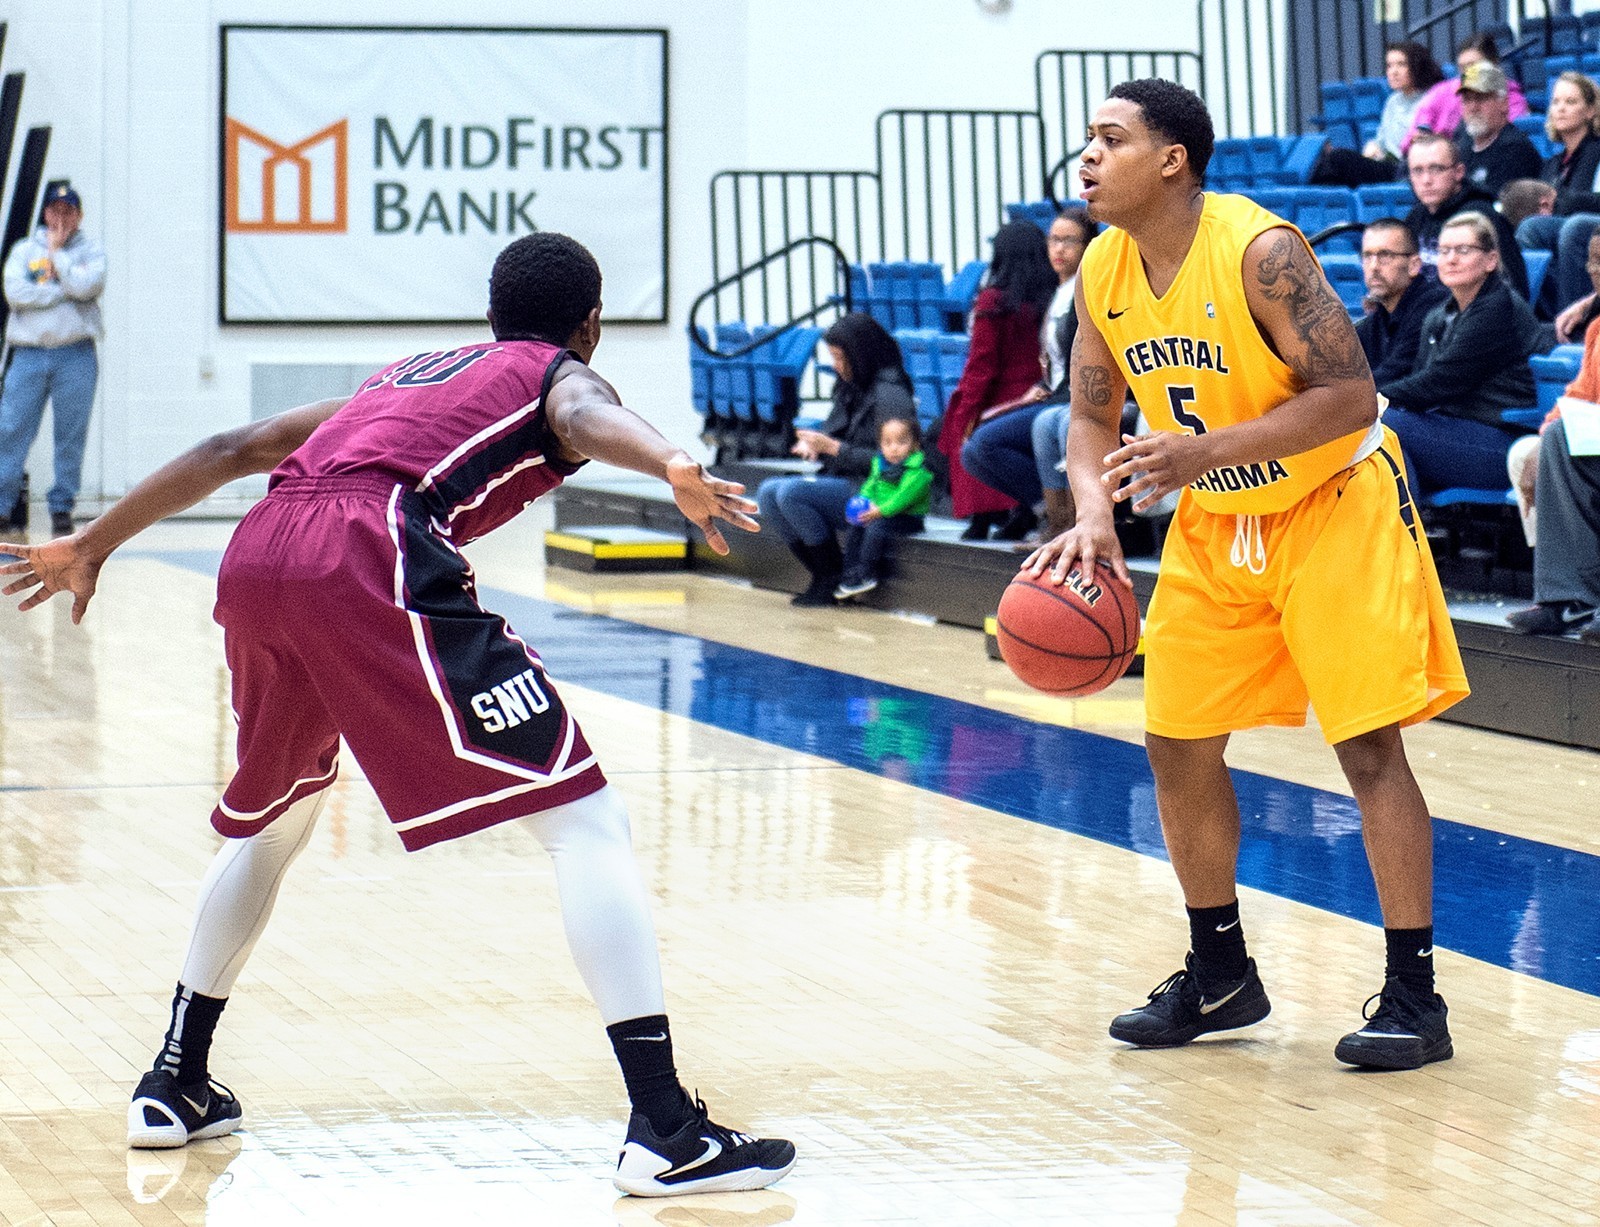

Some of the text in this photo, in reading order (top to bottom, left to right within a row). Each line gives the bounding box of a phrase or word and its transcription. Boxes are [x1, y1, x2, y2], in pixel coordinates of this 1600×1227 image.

[1124, 336, 1230, 376] CENTRAL
[1165, 384, 1209, 437] 5
[1189, 459, 1290, 493] AHOMA
[470, 668, 550, 733] SNU
